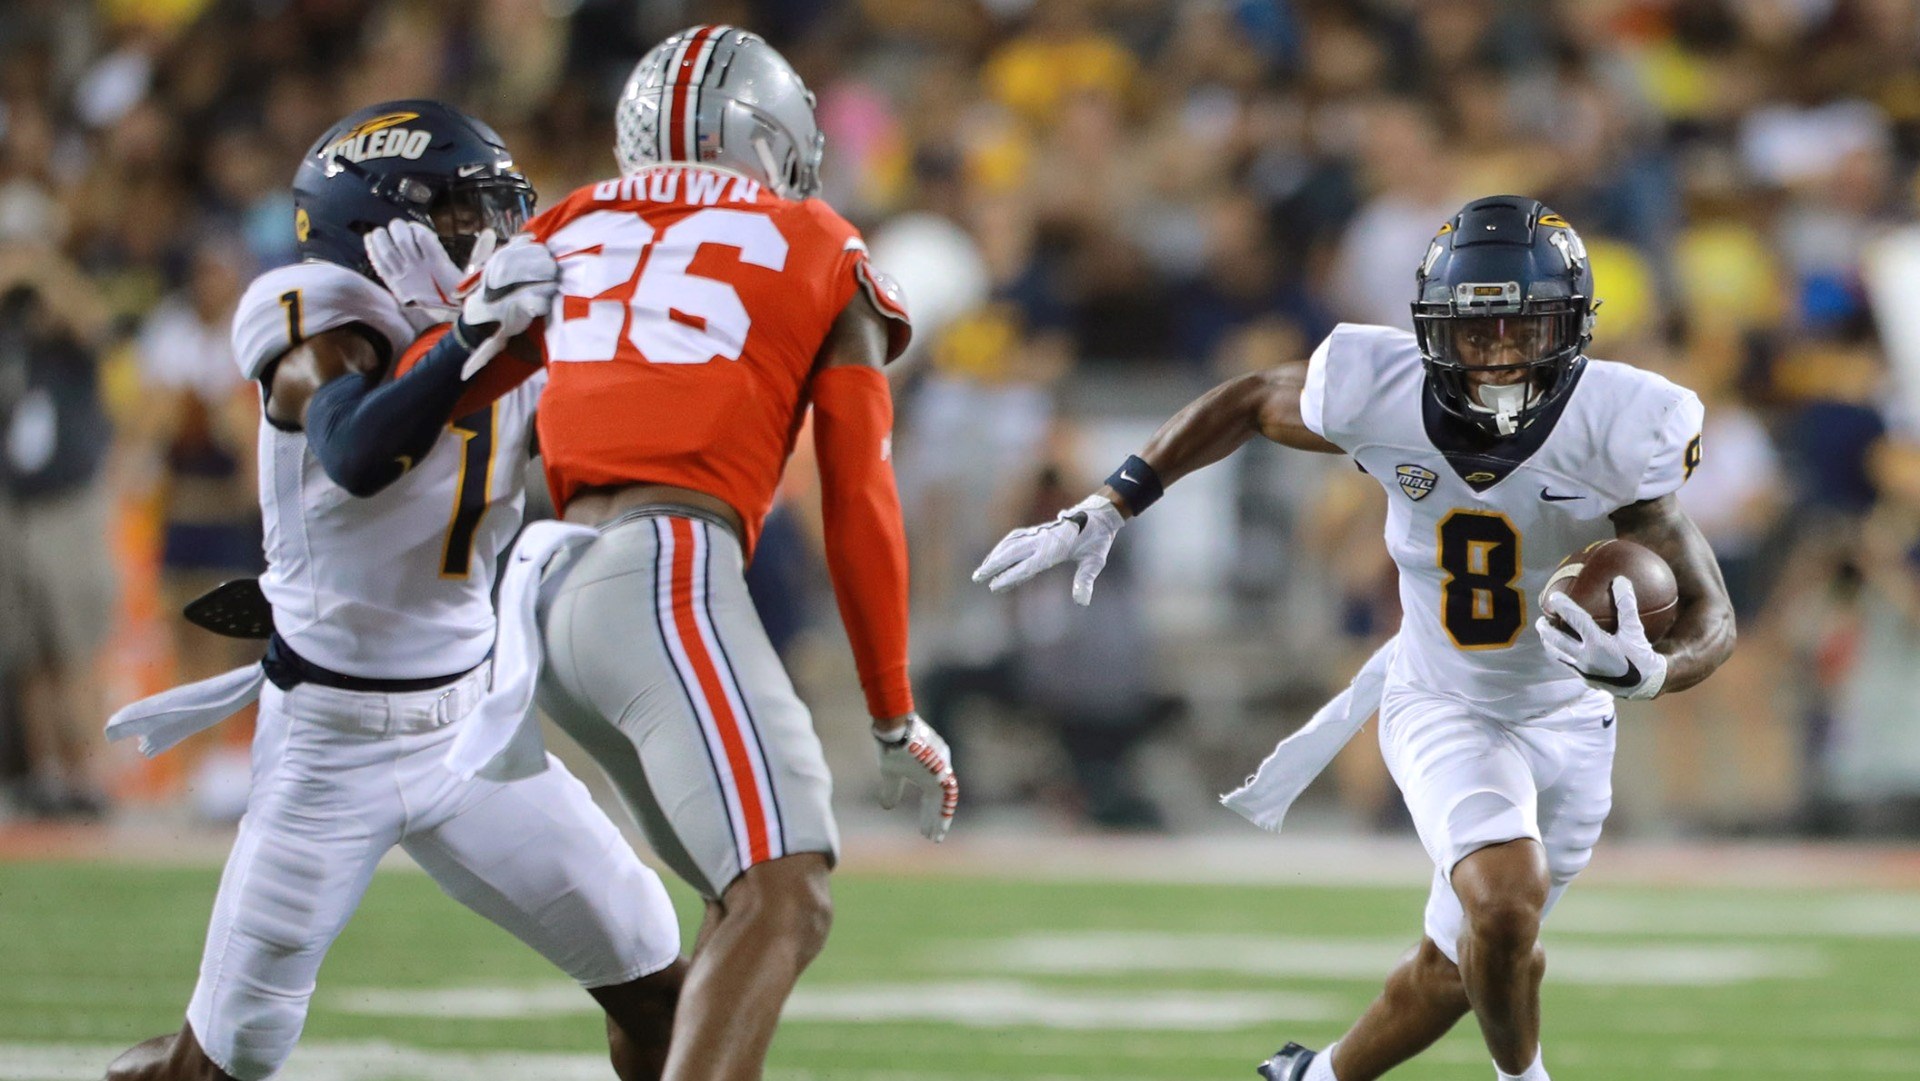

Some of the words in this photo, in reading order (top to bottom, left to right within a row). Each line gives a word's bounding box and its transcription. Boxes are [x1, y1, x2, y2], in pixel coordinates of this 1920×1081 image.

[278, 288, 304, 344] 1
[545, 208, 789, 364] 26
[438, 399, 500, 580] 1
[1436, 508, 1528, 651] 8
[908, 741, 945, 775] OHIO
